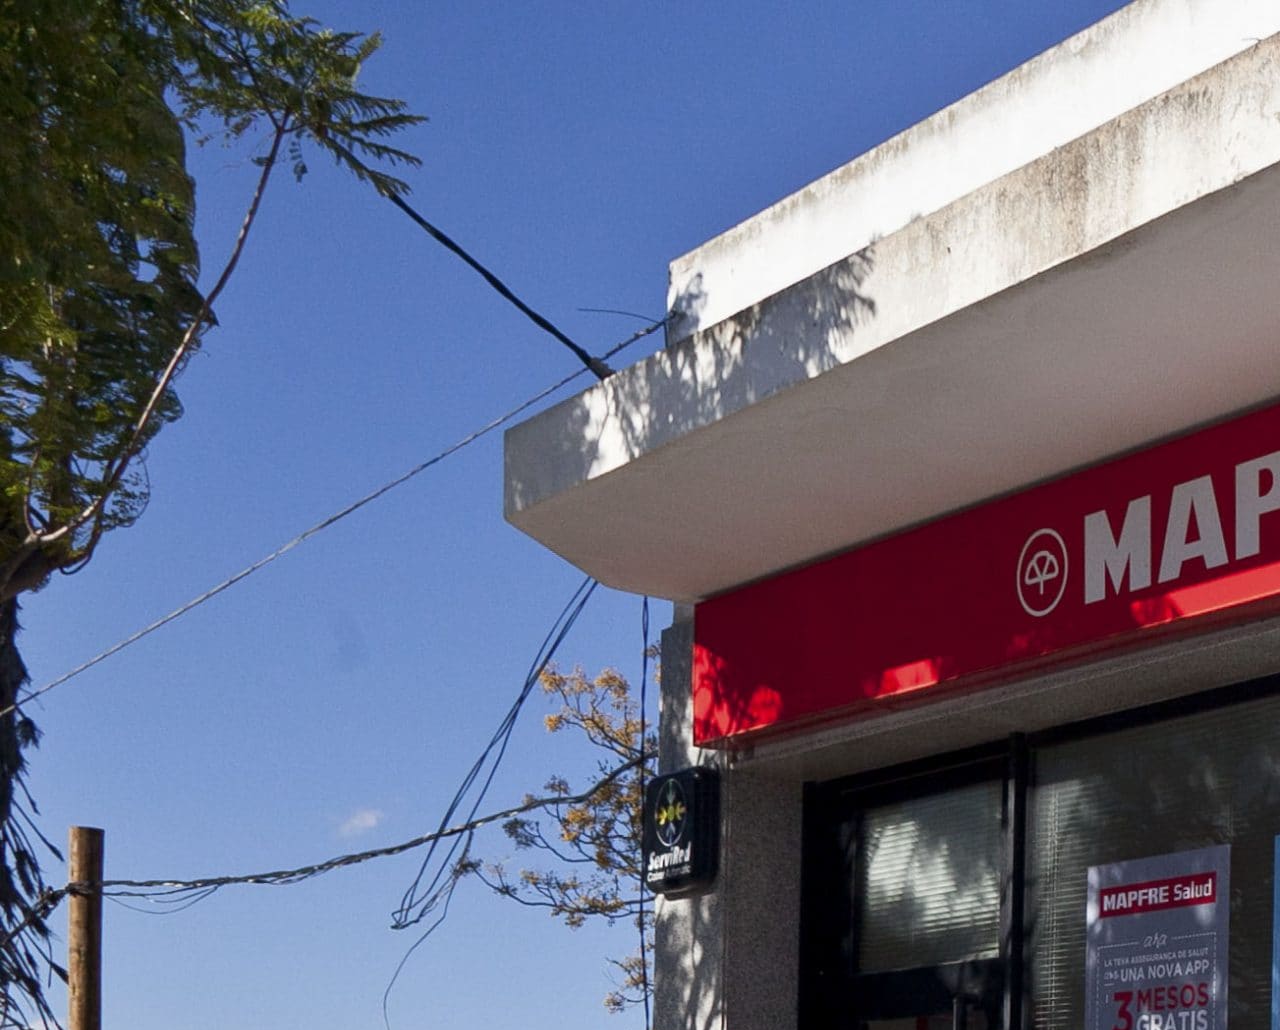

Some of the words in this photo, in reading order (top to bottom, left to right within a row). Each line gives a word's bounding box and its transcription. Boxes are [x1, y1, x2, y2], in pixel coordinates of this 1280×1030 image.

[648, 841, 691, 871] ServiRed
[1103, 886, 1169, 912] MAPFRE
[1173, 878, 1213, 901] Salud
[1120, 967, 1145, 982] UNA
[1148, 962, 1182, 979] NOVA
[1185, 959, 1210, 975] APP
[1136, 983, 1209, 1012] MESOS
